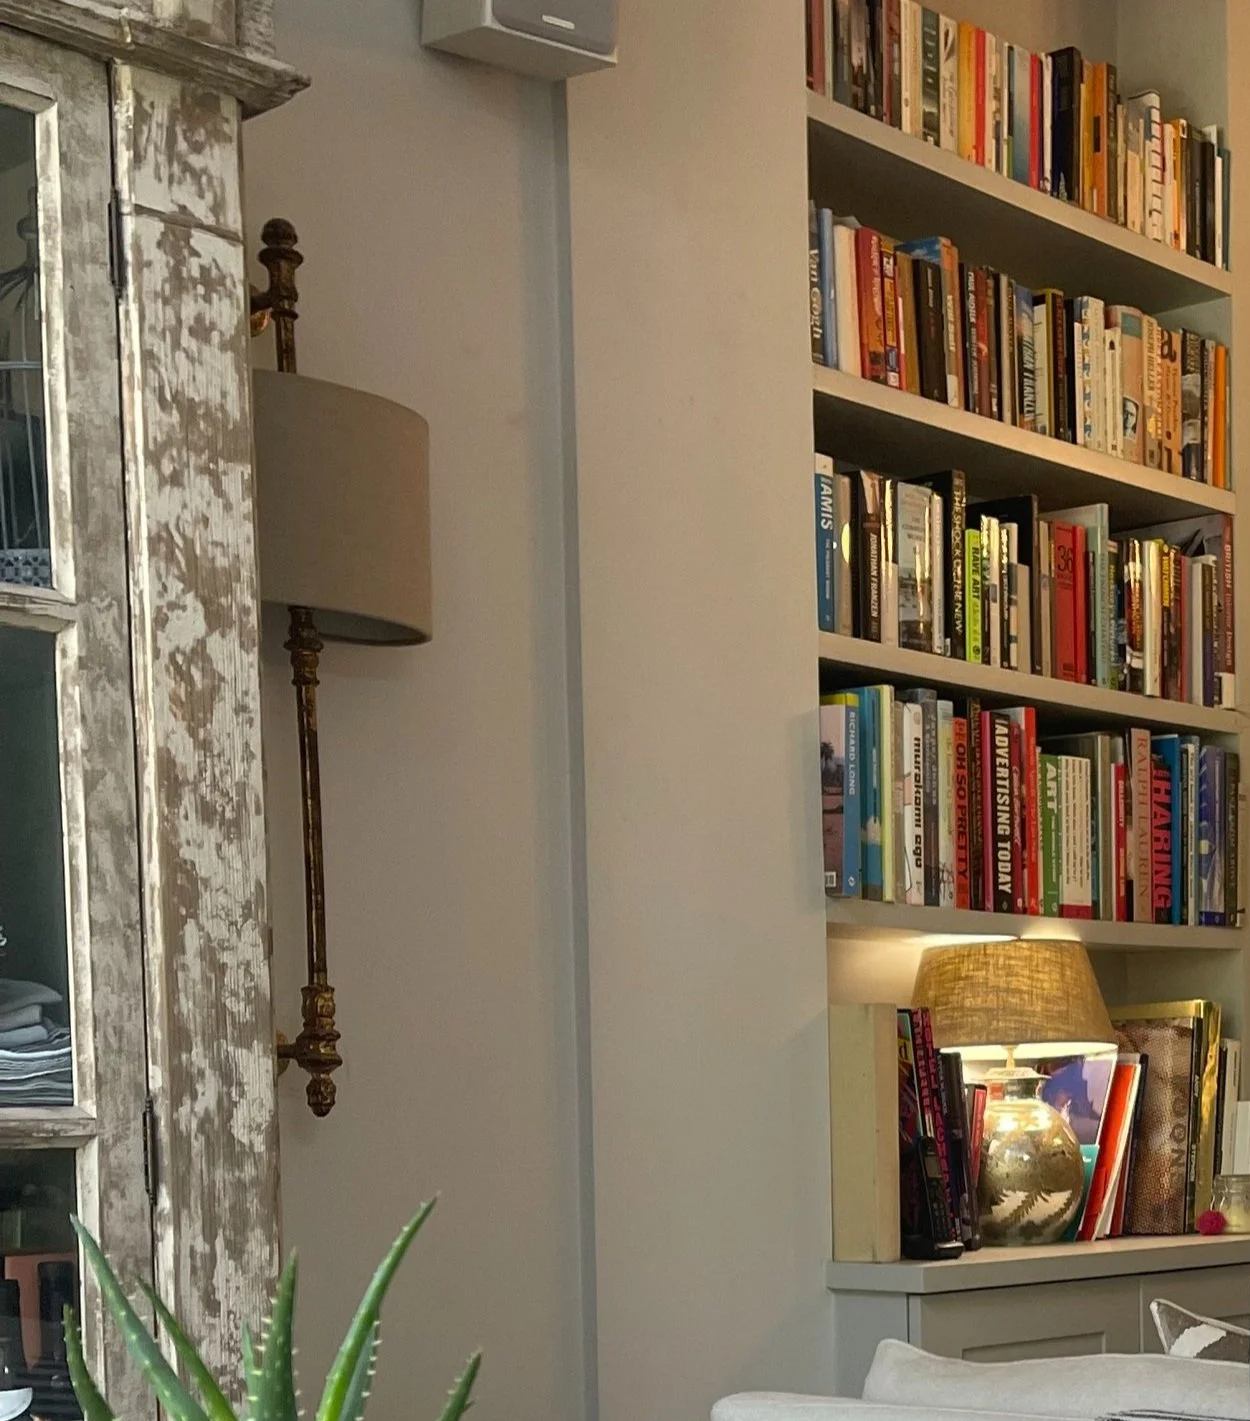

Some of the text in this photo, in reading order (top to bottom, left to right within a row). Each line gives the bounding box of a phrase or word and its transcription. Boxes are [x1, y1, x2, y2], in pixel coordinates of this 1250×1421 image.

[809, 248, 823, 339] Van Gogh
[820, 483, 833, 530] AMIS
[953, 514, 963, 556] SHOCK
[870, 533, 879, 618] JONATHAN FRANZEN
[972, 547, 981, 576] RAVE
[972, 578, 981, 600] ART
[848, 711, 857, 796] RICHARD LONG
[956, 743, 967, 770] OH
[957, 774, 967, 800] SO
[1046, 762, 1058, 814] ART
[912, 737, 923, 868] murakami ego
[995, 723, 1012, 893] ADVERTISING TODAY
[1137, 738, 1149, 897] RALPH LAUREN
[957, 804, 968, 879] PRETTY
[1153, 780, 1172, 908] HARING
